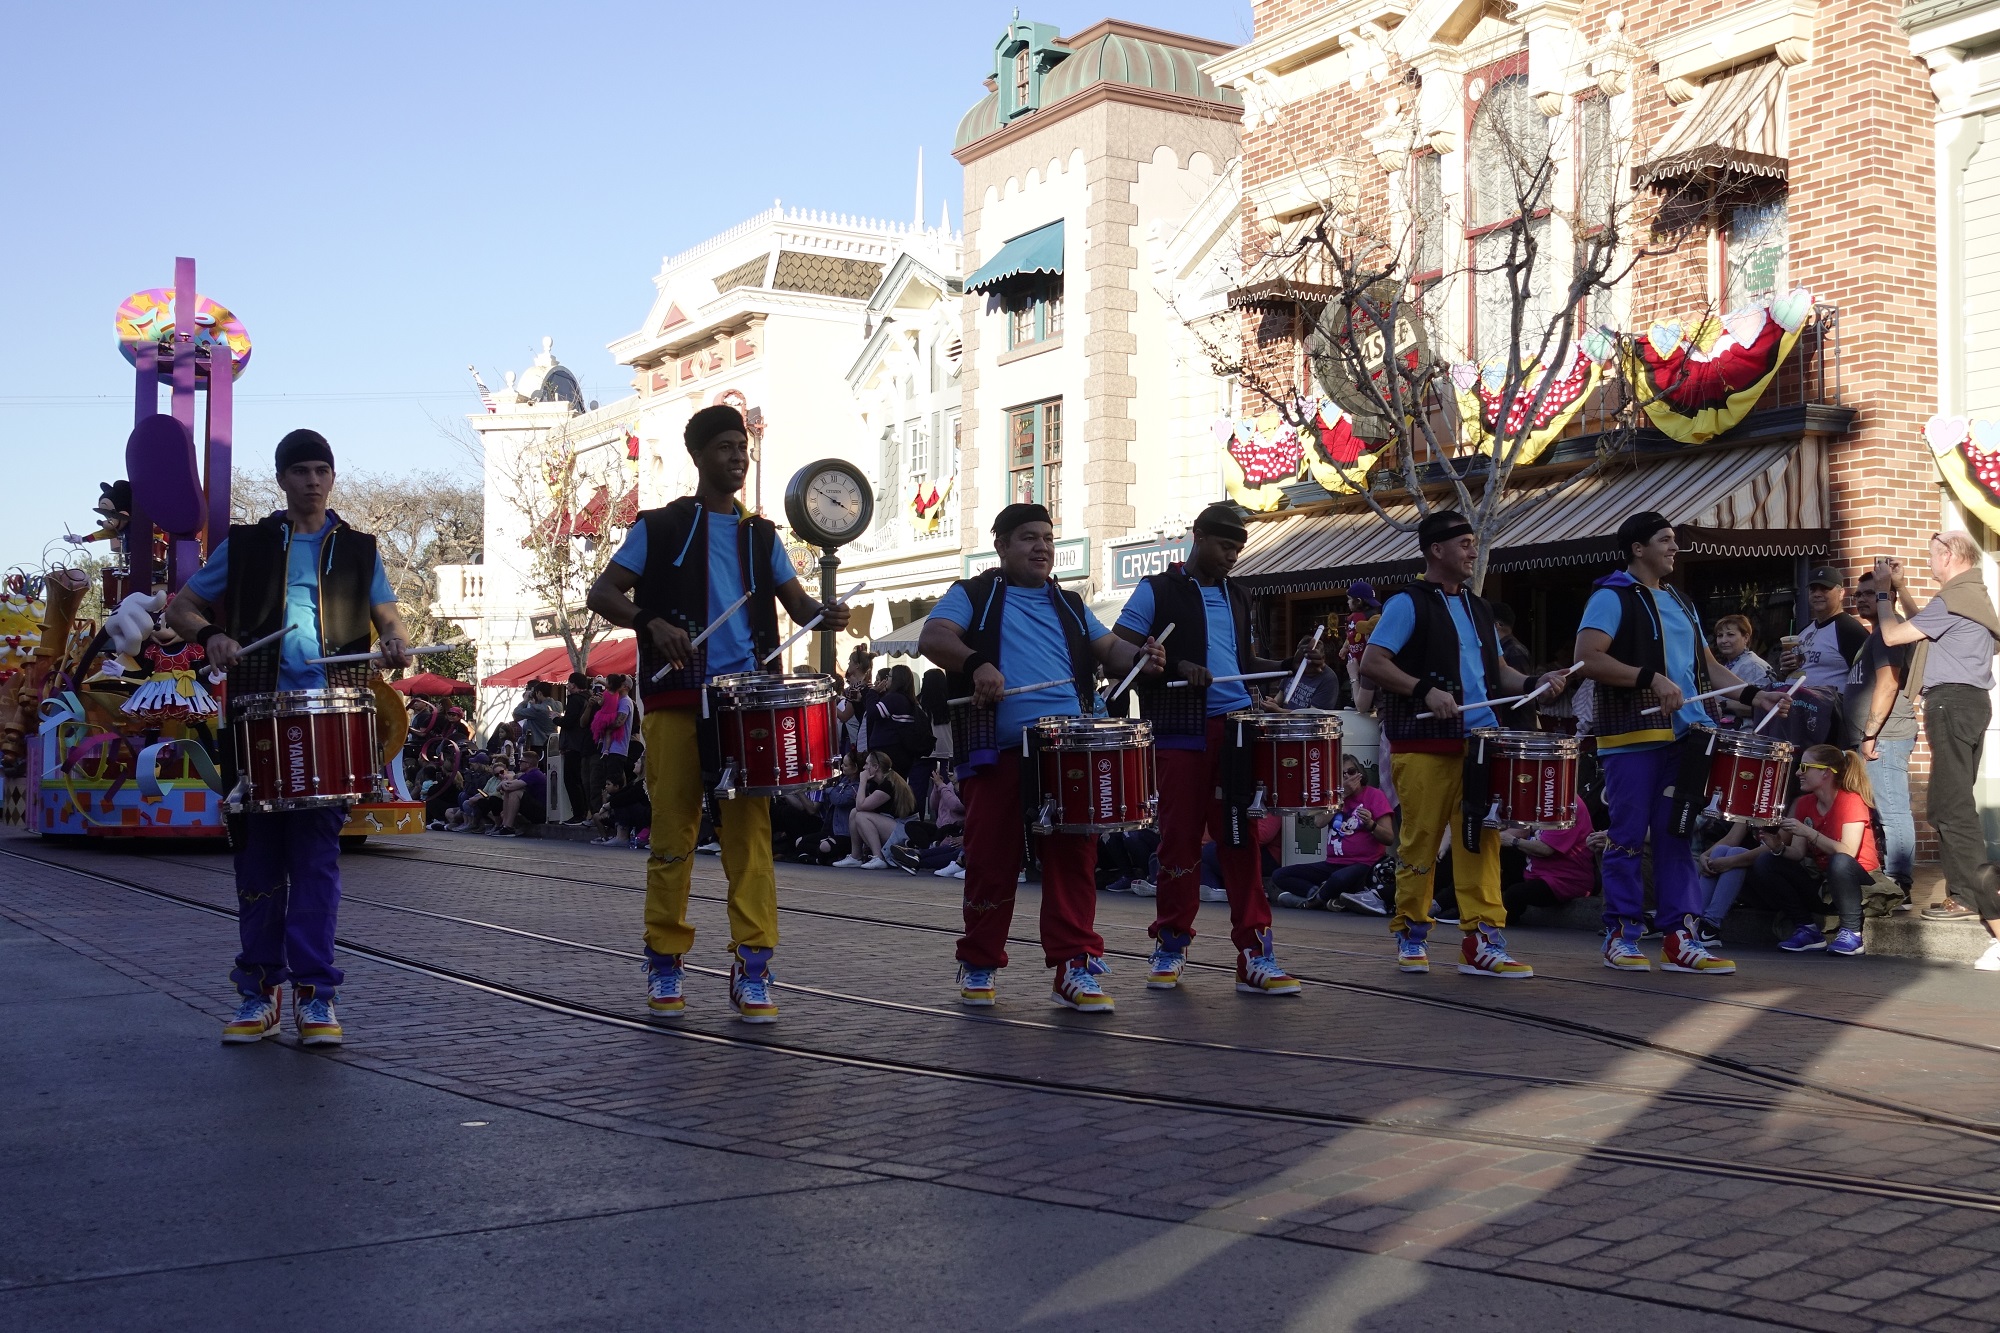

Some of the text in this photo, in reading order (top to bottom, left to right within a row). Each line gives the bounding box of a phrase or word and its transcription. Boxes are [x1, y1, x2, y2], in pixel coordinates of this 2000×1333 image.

[1053, 549, 1076, 568] UDIO
[288, 741, 306, 793] YAMAHA
[783, 730, 799, 779] YAMAHA
[1099, 772, 1114, 819] YAMAHA
[1310, 760, 1321, 803] YAMAHA
[1543, 778, 1555, 818] YAMAHA
[1759, 778, 1773, 814] YAMAHA
[1231, 815, 1241, 846] YAMAHA
